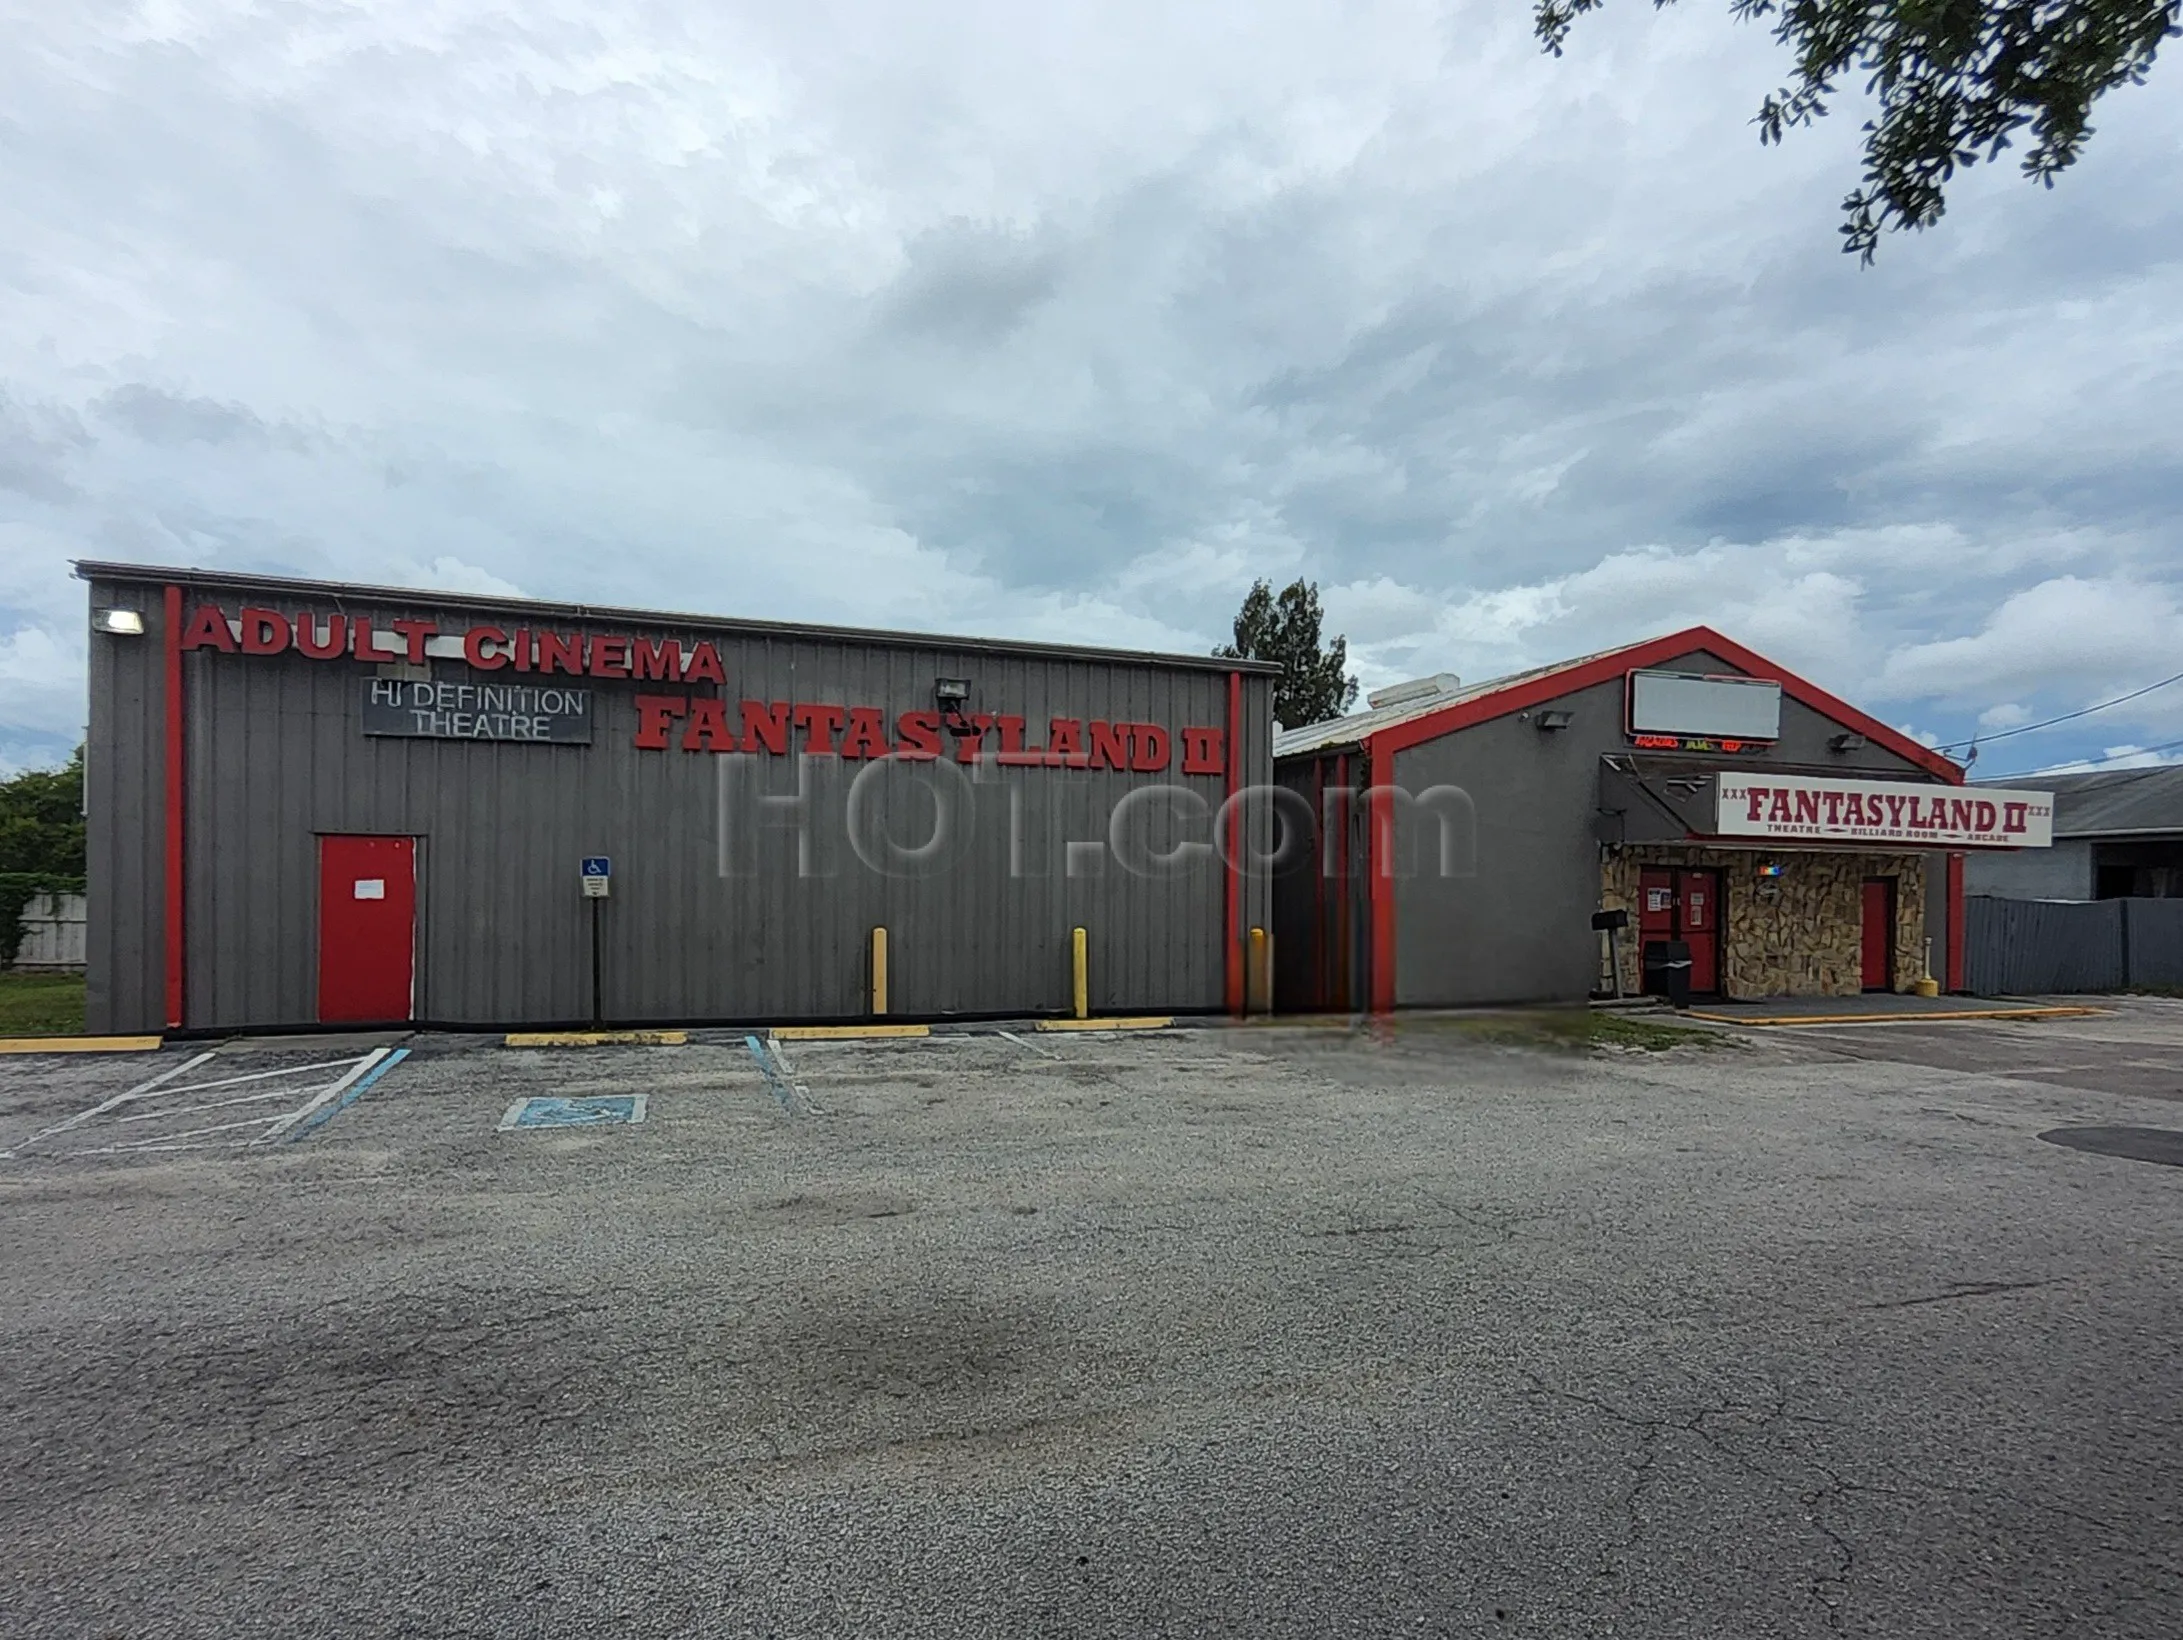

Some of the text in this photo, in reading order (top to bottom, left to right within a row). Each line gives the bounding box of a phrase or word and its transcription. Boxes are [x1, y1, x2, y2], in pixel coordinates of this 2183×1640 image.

[181, 605, 727, 685] ADULT CINEMA
[371, 680, 583, 716] HI DEFINITION
[409, 708, 551, 741] THEATRE
[634, 694, 1224, 775] FANTASYLAND II
[1722, 788, 1747, 800] XXX
[1747, 787, 1997, 832] FANTASYLAND
[2002, 802, 2028, 833] II
[1767, 823, 2009, 842] THEATRE BILLIARD ROOM ARCADE
